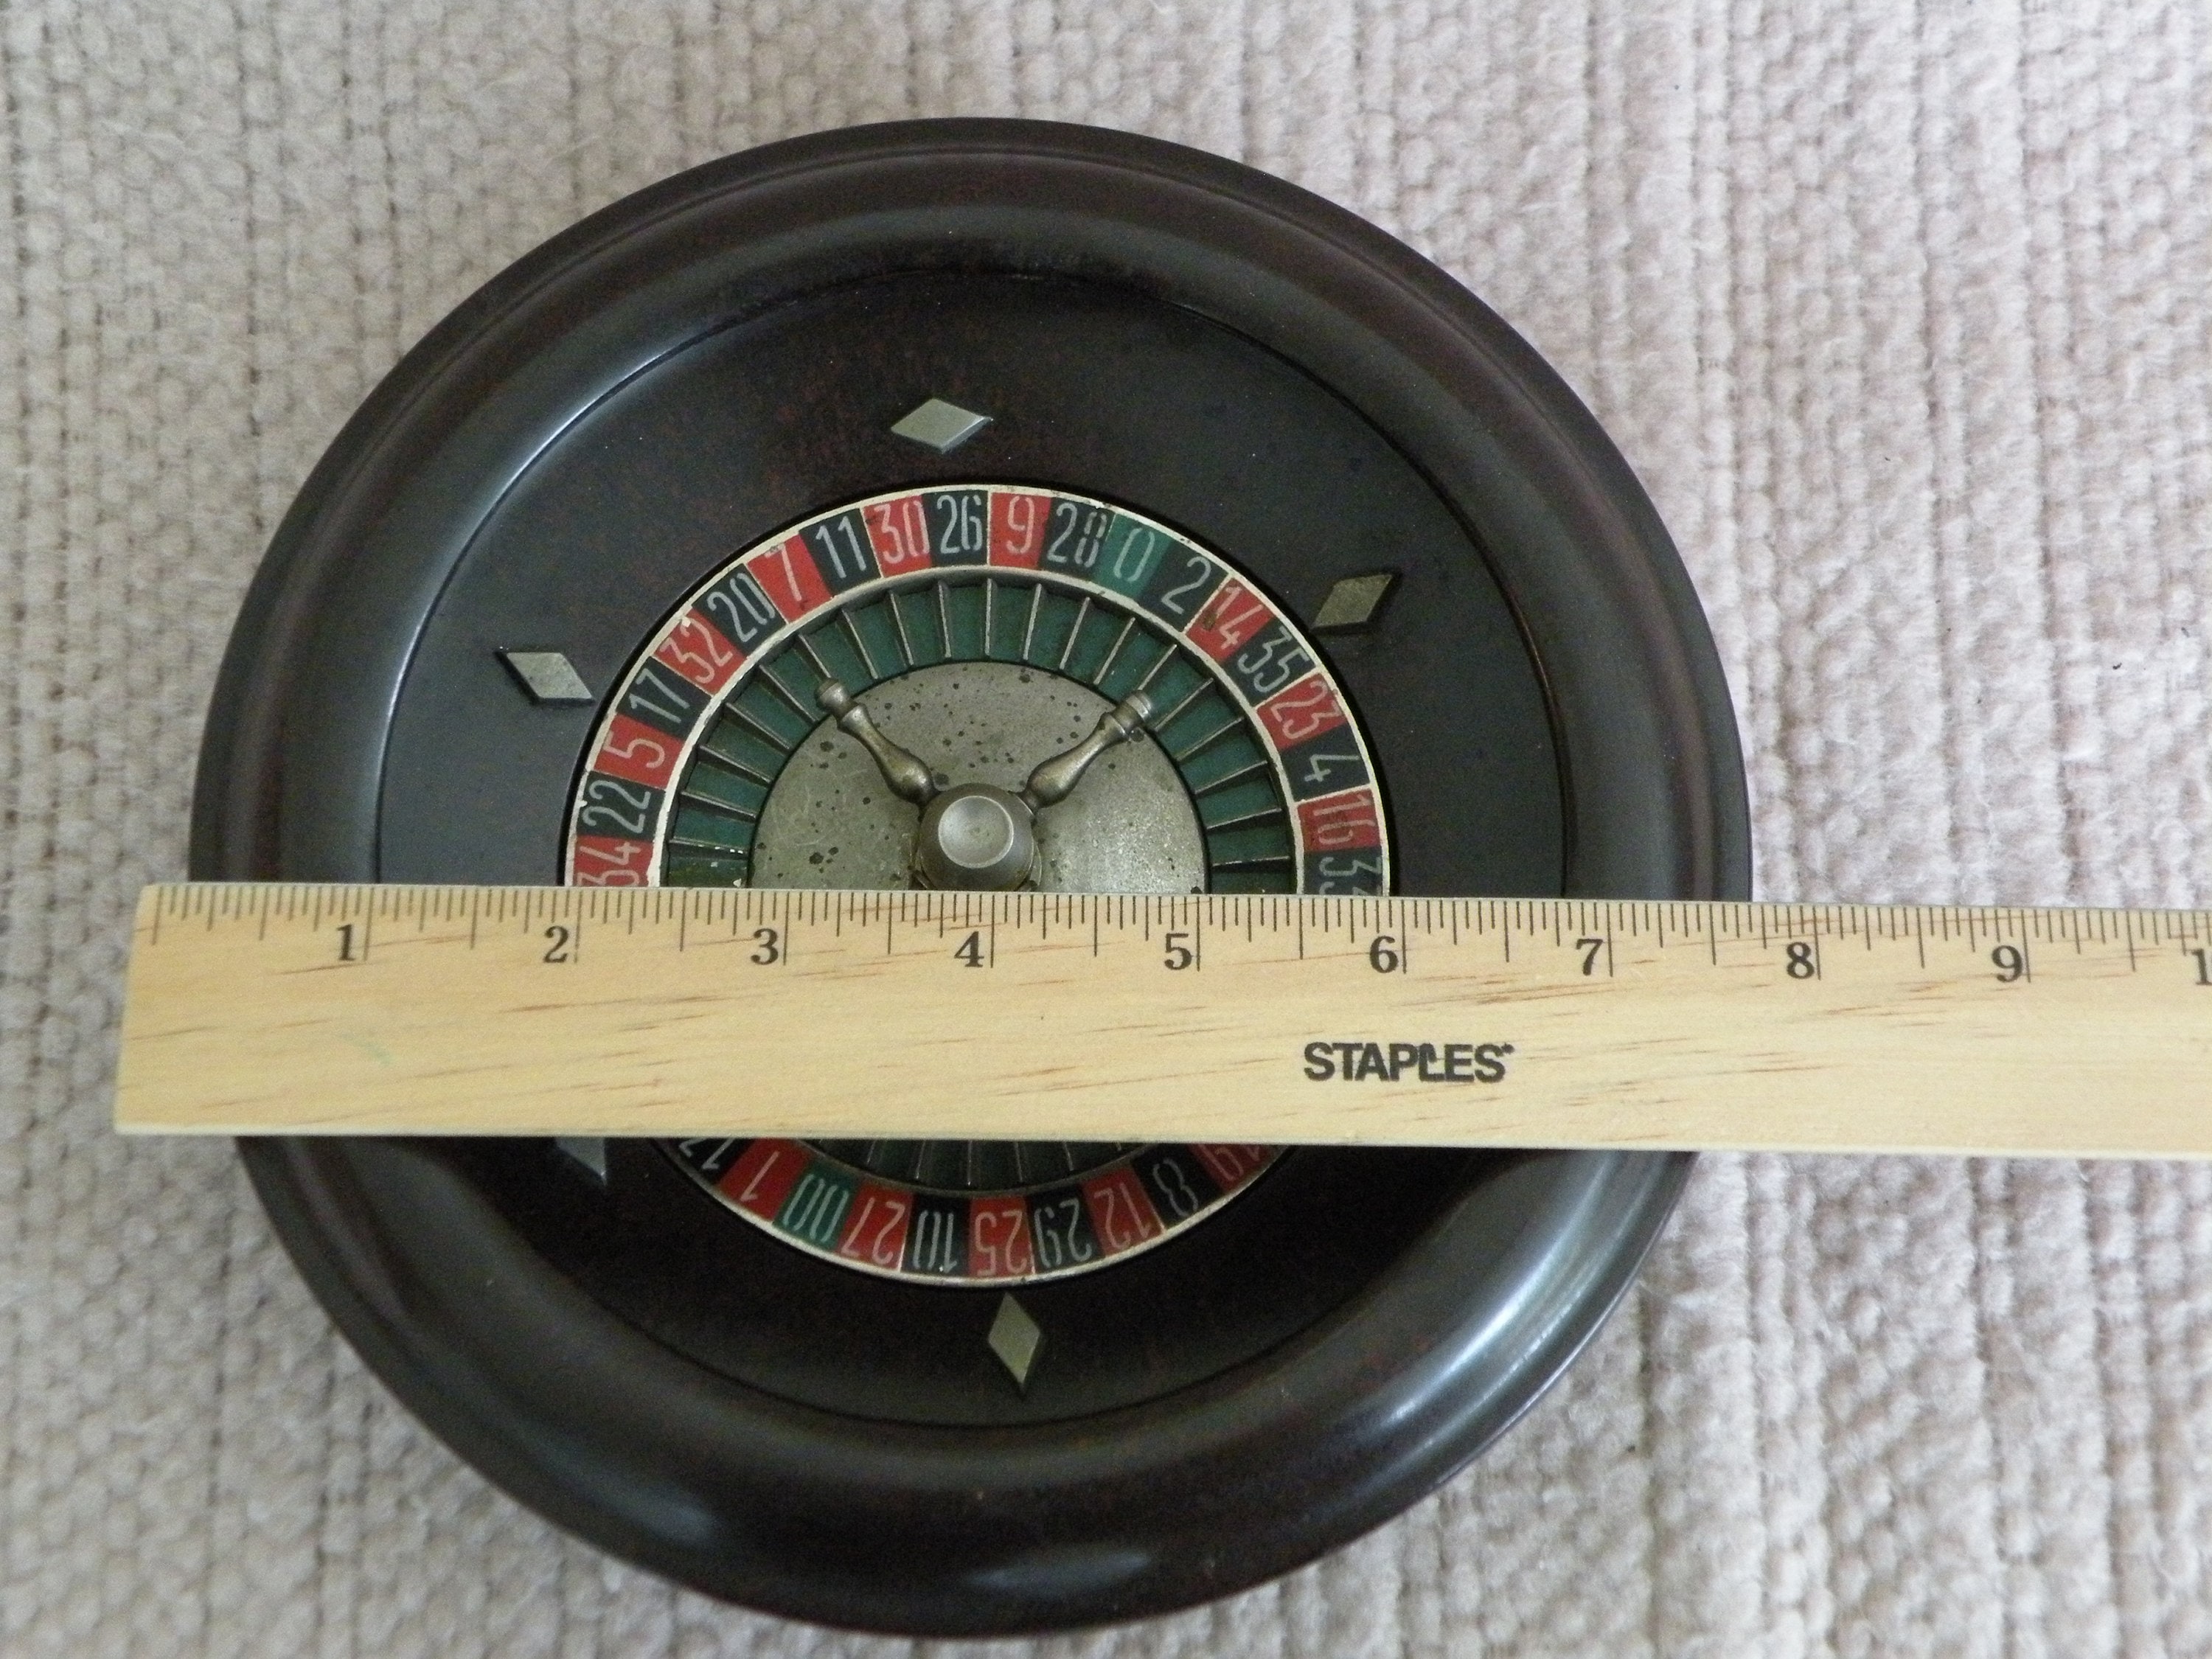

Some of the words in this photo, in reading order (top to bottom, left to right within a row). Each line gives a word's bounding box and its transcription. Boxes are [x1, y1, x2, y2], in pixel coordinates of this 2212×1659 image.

[815, 515, 867, 579] 11
[874, 499, 931, 565] 30
[936, 494, 984, 554] 26
[1006, 495, 1035, 554] 9
[1047, 503, 1106, 568] 28
[1113, 527, 1155, 582] 0
[764, 543, 803, 602] 7
[1161, 556, 1214, 614] 2
[707, 572, 776, 643] 20
[1215, 582, 1265, 650] 14
[658, 615, 734, 685] 32
[1237, 627, 1310, 693] 35
[630, 667, 690, 724] 17
[1270, 680, 1341, 740] 23
[602, 730, 665, 769] 5
[1304, 753, 1361, 783] 4
[582, 779, 651, 835] 22
[1313, 794, 1376, 845] 16
[335, 924, 358, 963] 1
[542, 925, 569, 964] 2
[750, 928, 779, 966] 3
[954, 931, 984, 968] 4
[1164, 933, 1192, 972] 5
[1368, 935, 1399, 974] 6
[1575, 937, 1604, 977] 7
[1785, 942, 1816, 980] 8
[1991, 945, 2023, 984] 9
[2191, 948, 2212, 986] 1
[1304, 1041, 1506, 1084] STAPLES
[740, 1150, 780, 1203] 1
[1152, 1158, 1200, 1218] 8
[782, 1173, 850, 1243] 00
[841, 1197, 906, 1266] 27
[1033, 1197, 1093, 1270] 29
[1094, 1181, 1152, 1252] 12
[912, 1209, 958, 1274] 10
[974, 1208, 1028, 1278] 25
